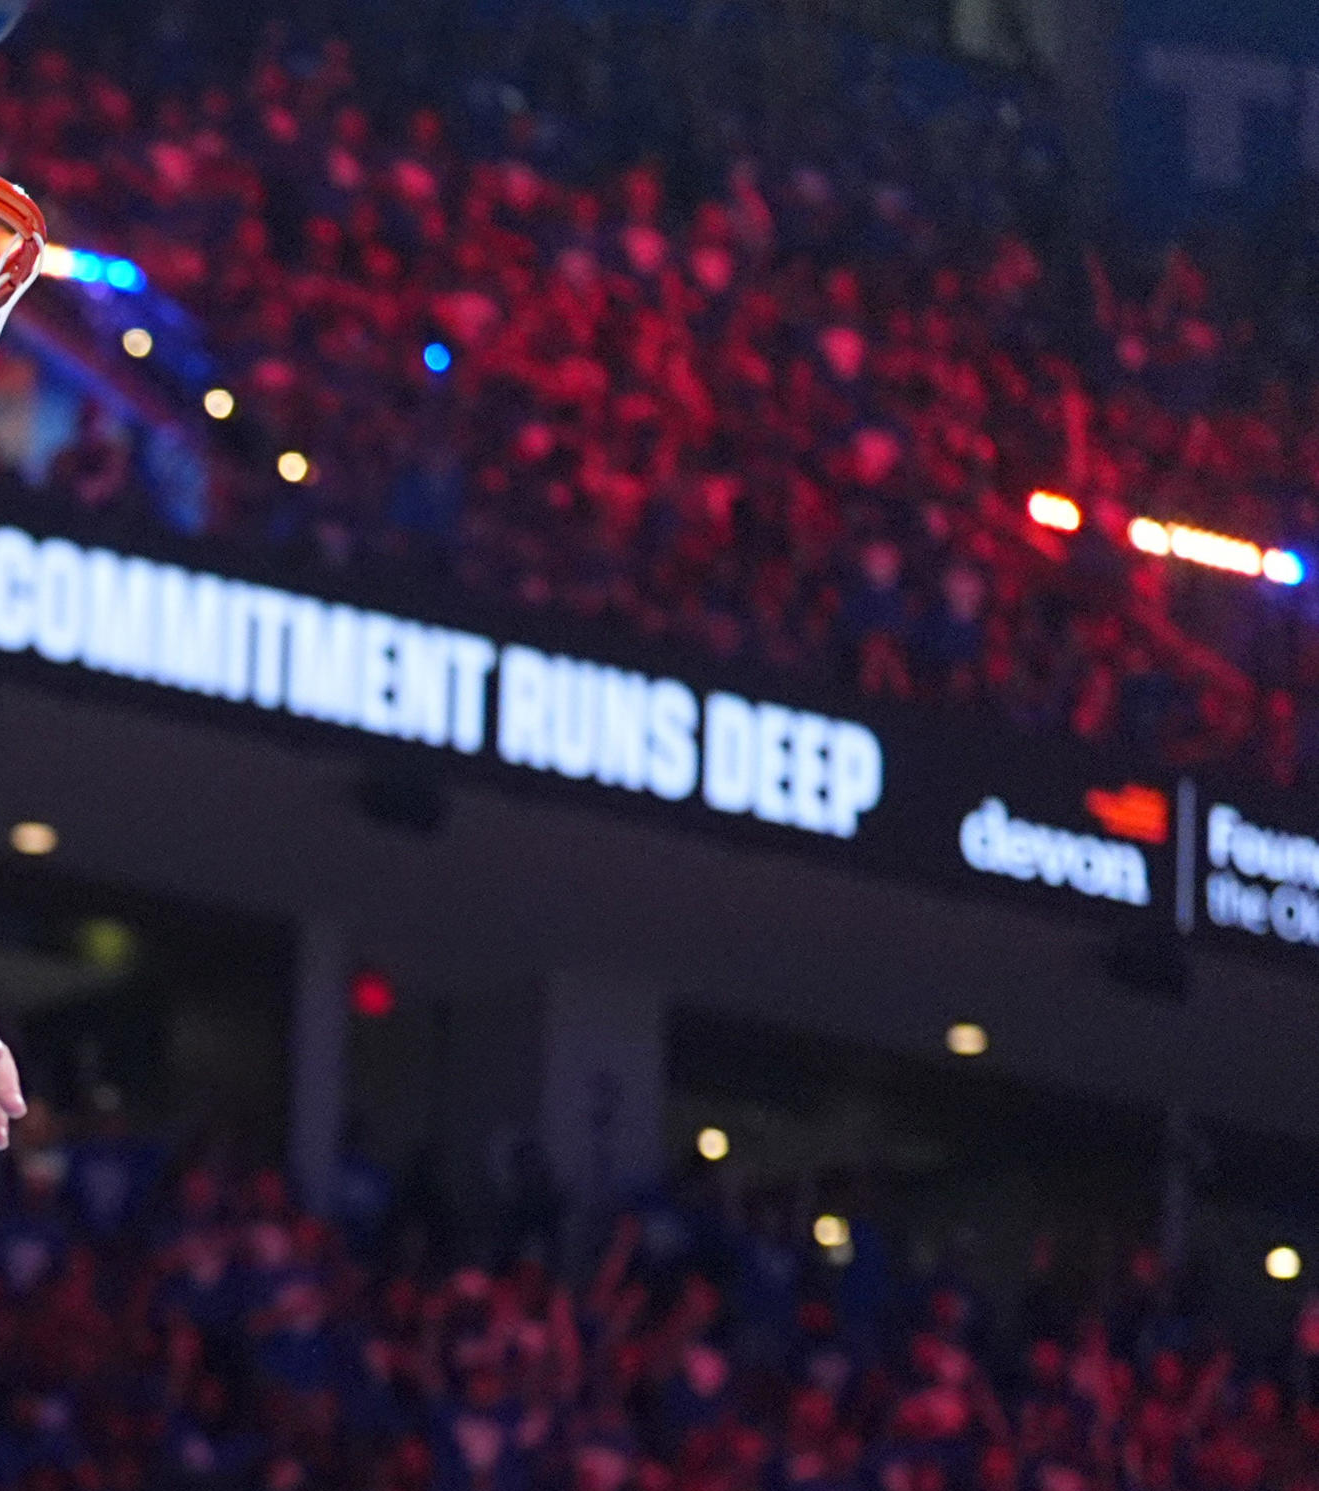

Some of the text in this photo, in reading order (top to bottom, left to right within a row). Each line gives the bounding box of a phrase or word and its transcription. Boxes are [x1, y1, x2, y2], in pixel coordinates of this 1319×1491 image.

[497, 643, 700, 801] RUNS
[703, 690, 883, 839] DEEP
[959, 796, 1151, 906] devon
